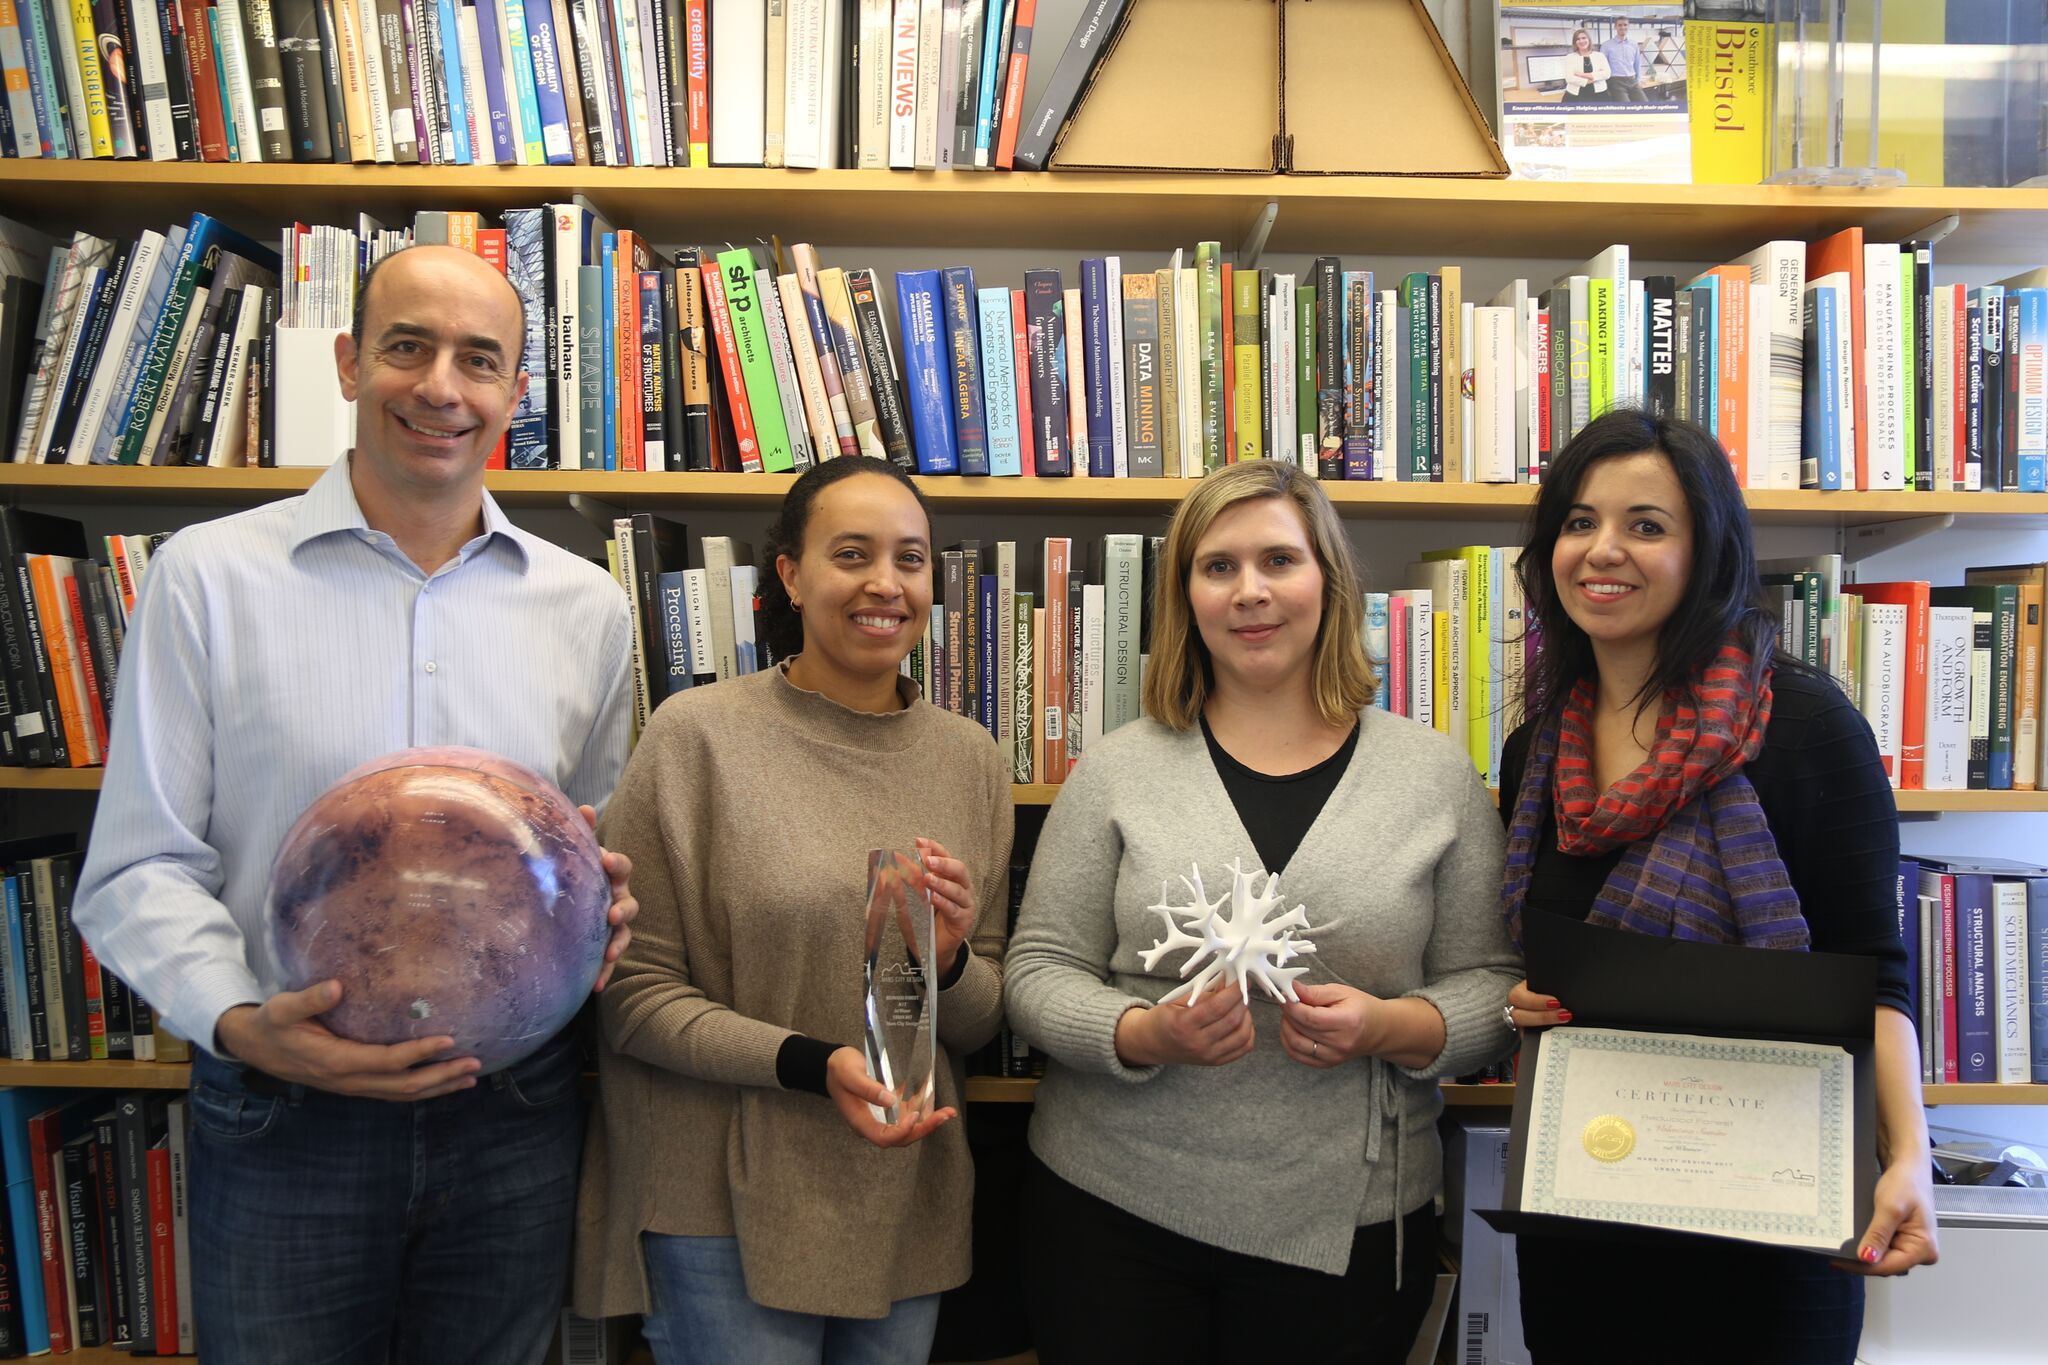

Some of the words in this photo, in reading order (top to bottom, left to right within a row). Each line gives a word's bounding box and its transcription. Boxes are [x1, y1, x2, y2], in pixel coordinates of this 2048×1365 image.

[194, 8, 207, 60] PROFESSIONAL
[392, 14, 402, 50] ARCHITECTURE
[506, 3, 524, 47] flow
[808, 6, 818, 53] NATURAL
[1079, 24, 1096, 49] Design
[1091, 16, 1099, 24] of
[188, 36, 200, 75] CREATIVITY
[531, 35, 540, 48] OF
[540, 23, 558, 93] COMPUTABILITY
[689, 9, 705, 79] creativity
[81, 40, 104, 116] INVISIBLES
[297, 64, 305, 88] Second
[347, 50, 358, 92] MODERNISM
[367, 54, 378, 85] Circle
[408, 47, 419, 90] Engineering
[534, 51, 546, 85] DESIGN
[578, 42, 595, 99] Statistics
[895, 48, 914, 117] VIEWS
[1012, 57, 1022, 83] Structural
[1714, 25, 1746, 133] Bristol
[1748, 41, 1759, 94] Strathmore
[300, 90, 310, 128] Modernism
[371, 88, 383, 131] Favored
[412, 91, 422, 120] Legends
[808, 57, 818, 125] CURIOSITIES
[876, 84, 884, 126] MATERIALS
[1006, 84, 1018, 118] Optimization
[1036, 108, 1055, 137] Robertson
[376, 137, 386, 153] The
[139, 245, 151, 263] the
[123, 266, 145, 311] constant
[1413, 287, 1419, 296] IN
[1780, 259, 1789, 297] DESIGN
[1789, 259, 1798, 325] GENERATIVE
[684, 273, 694, 326] philosophy
[921, 292, 935, 342] CALCULUS
[956, 284, 966, 319] STRANG
[1161, 286, 1171, 341] DESCRIPTIVE
[1354, 284, 1362, 323] Creative
[1431, 282, 1440, 326] Computational
[1598, 288, 1607, 339] MAKING
[562, 315, 574, 380] bauhaus
[643, 344, 652, 356] OF
[738, 316, 756, 363] architects
[954, 331, 966, 367] LINEAR
[984, 310, 998, 355] Scientists
[996, 310, 1008, 362] Numerical
[1046, 316, 1058, 365] Numerical
[1375, 302, 1383, 374] Performance-Oriented
[1420, 330, 1426, 339] OF
[1431, 328, 1440, 348] Design
[1538, 323, 1548, 374] MAKERS
[1570, 320, 1589, 380] FAB
[1599, 341, 1607, 355] IT
[1652, 298, 1672, 374] MATTER
[1680, 316, 1689, 353] Subnature
[1886, 284, 1894, 379] MANUFACTURING
[1969, 317, 1981, 362] Scripting
[130, 375, 158, 431] ROBERT
[148, 291, 187, 372] MAILLART
[228, 345, 241, 379] WERNER
[580, 326, 601, 410] SHAPE
[652, 344, 661, 373] MATRIX
[987, 357, 999, 378] and
[1139, 343, 1151, 381] DATA
[1163, 343, 1173, 388] GEOMETRY
[1207, 332, 1216, 394] BEAUTIFUL
[1243, 354, 1252, 381] Parallel
[1353, 327, 1363, 384] Evolutionary
[1431, 349, 1440, 376] Thinking
[1555, 330, 1564, 397] FABRICATED
[2025, 344, 2043, 394] OPTIMUM
[223, 381, 234, 408] SOBEK
[643, 358, 654, 412] STRUCTURES
[653, 376, 662, 412] ANALYSIS
[957, 371, 969, 419] ALGEBRA
[988, 380, 1001, 430] Engineers
[1000, 365, 1011, 411] Methods
[1049, 367, 1060, 405] Methods
[1243, 383, 1253, 425] Coordinates
[1375, 375, 1383, 398] Design
[1877, 357, 1886, 449] PROFESSIONALS
[1971, 364, 1981, 404] Cultures
[1001, 413, 1012, 428] for
[1140, 386, 1153, 443] MINING
[1354, 388, 1362, 423] Systems
[2025, 398, 2044, 435] DESIGN
[1209, 401, 1218, 458] EVIDENCE
[132, 550, 143, 571] ARUP
[967, 562, 975, 574] THE
[691, 576, 701, 611] DESIGN
[967, 575, 975, 616] STRUCTURAL
[1001, 588, 1010, 611] DESIGN
[1118, 561, 1130, 636] STRUCTURAL
[1419, 601, 1430, 623] The
[667, 588, 686, 676] Processing
[694, 616, 701, 625] IN
[949, 611, 960, 666] Structural
[968, 617, 976, 636] BASIS
[968, 637, 976, 646] OF
[1002, 613, 1010, 632] AND
[1883, 629, 1892, 646] AN
[2000, 611, 2009, 668] FOUNDATION
[633, 654, 640, 663] in
[695, 631, 705, 667] NATURE
[1001, 634, 1010, 675] TECHNOLOGY
[1090, 617, 1102, 676] structures
[1117, 640, 1128, 685] DESIGN
[1419, 628, 1431, 707] Architectural
[1942, 644, 1952, 675] AND
[1954, 636, 1966, 658] ON
[968, 648, 976, 694] ARCHITECTURE
[1001, 677, 1010, 687] IN
[1954, 661, 1966, 723] GROWTH
[634, 667, 647, 727] Architecture
[1001, 688, 1010, 739] ARCHITECTURE
[1880, 652, 1891, 750] AUTOBIOGRAPHY
[1941, 678, 1952, 716] FORM
[1998, 671, 2008, 729] ENGINEERING
[1944, 884, 1952, 908] DESIGN
[1944, 910, 1952, 953] ENGINEERING
[1973, 908, 1984, 969] STRUCTURAL
[2005, 915, 2017, 956] SOLID
[1945, 955, 1953, 997] REFOCUSSED
[1975, 971, 1985, 1016] ANALYSIS
[2006, 959, 2018, 1038] MECHANICS
[1615, 1088, 1766, 1110] CERTIFICATE
[39, 1190, 51, 1231] Simplified
[69, 1181, 85, 1219] Visual
[132, 1188, 141, 1223] WORKS
[41, 1233, 54, 1261] Design
[72, 1222, 89, 1279] Statistics
[133, 1225, 144, 1275] COMPLETE
[138, 1276, 147, 1304] KUMA
[140, 1307, 149, 1338] KENGO
